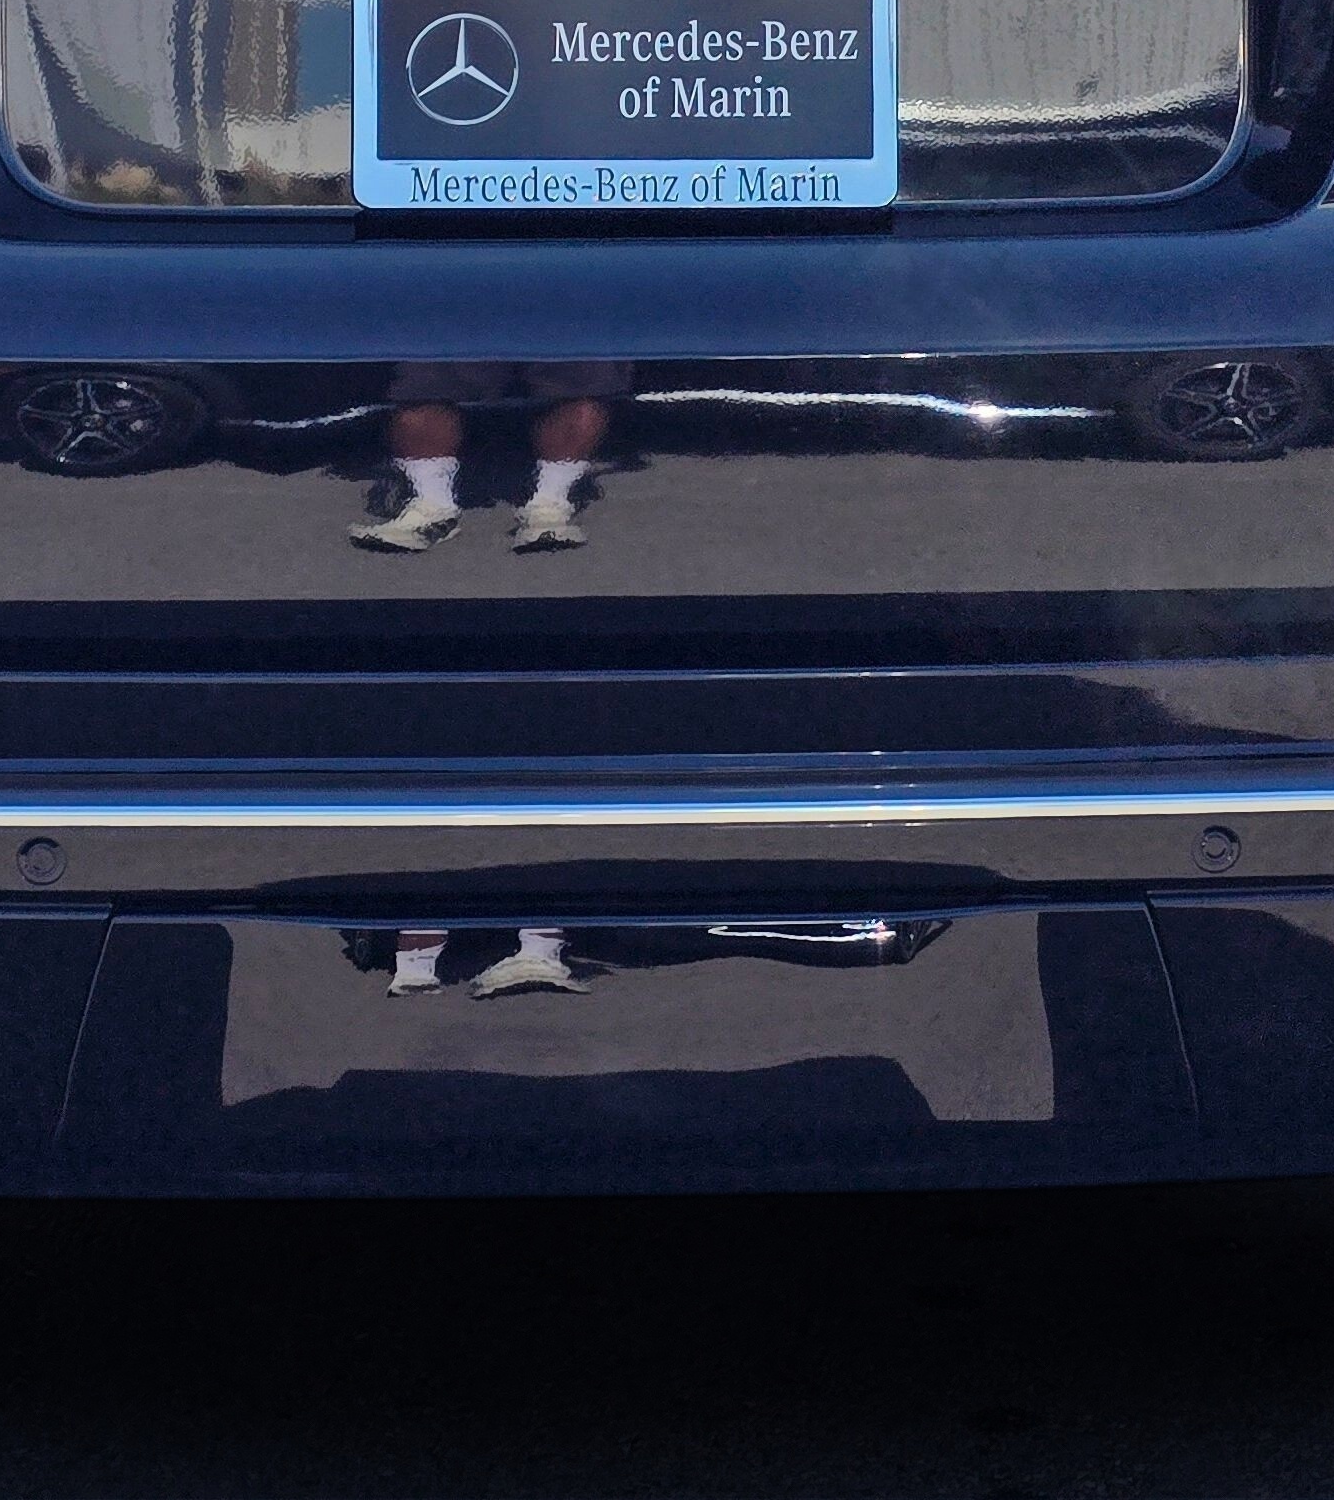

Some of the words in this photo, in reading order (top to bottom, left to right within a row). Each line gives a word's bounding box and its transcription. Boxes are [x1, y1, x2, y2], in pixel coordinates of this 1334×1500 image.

[551, 20, 859, 63] Mercedes-Benz
[618, 76, 660, 120] of
[670, 75, 792, 119] Marin
[409, 165, 679, 204] Mercedes-Benz
[690, 164, 725, 204] of
[737, 164, 842, 203] Marin
